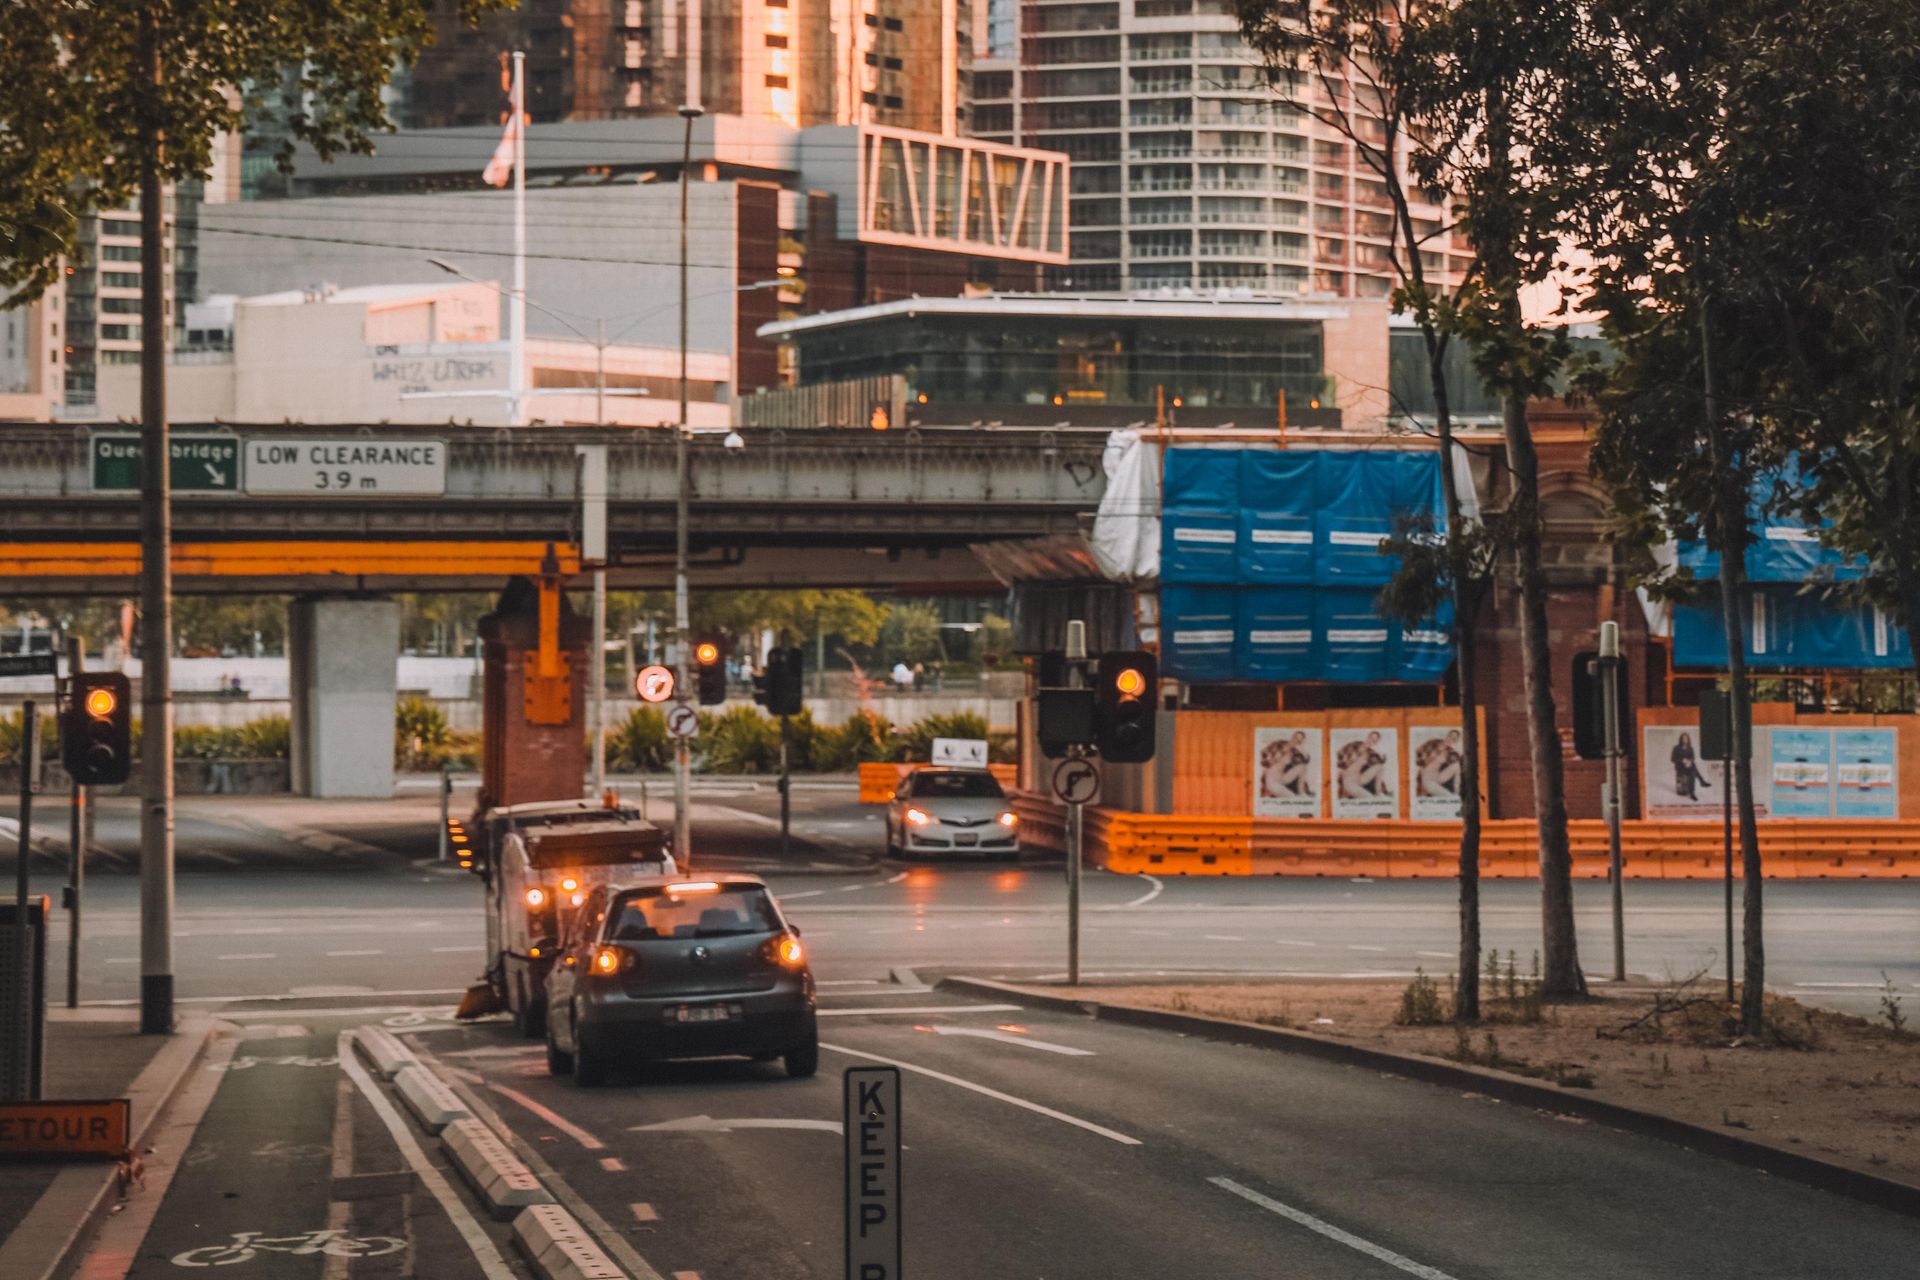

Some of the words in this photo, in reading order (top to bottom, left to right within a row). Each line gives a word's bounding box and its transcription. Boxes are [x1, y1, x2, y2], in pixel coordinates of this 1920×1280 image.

[99, 442, 234, 462] Quebridge
[256, 446, 298, 465] LOW
[310, 446, 435, 465] CLEARANCE
[360, 476, 377, 489] m
[858, 1081, 887, 1238] KEEP
